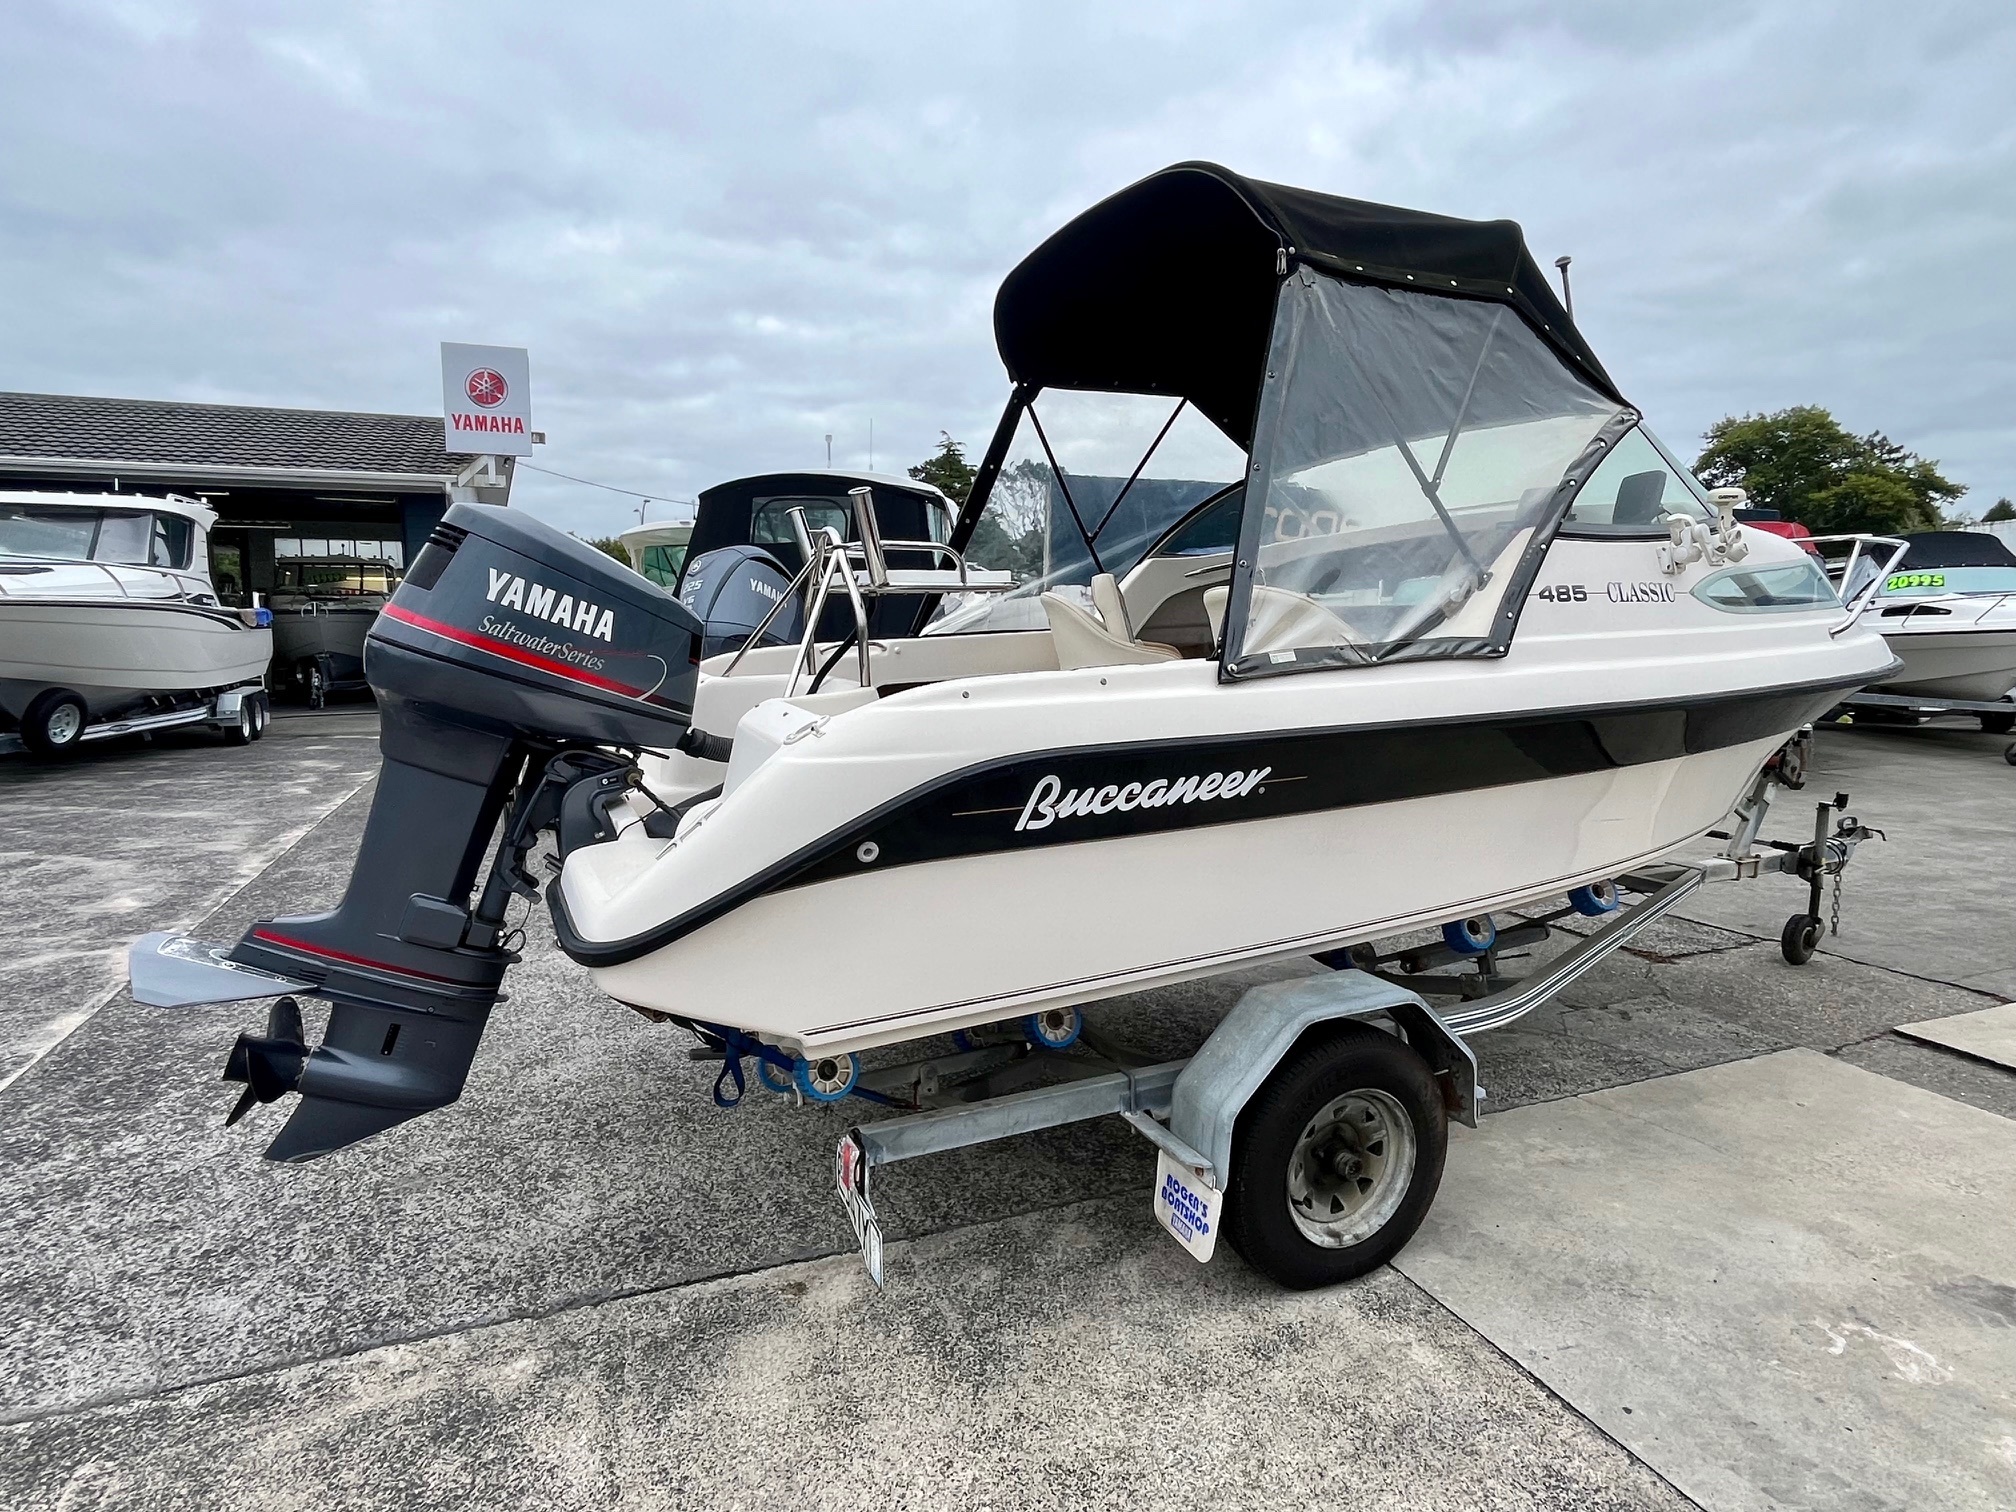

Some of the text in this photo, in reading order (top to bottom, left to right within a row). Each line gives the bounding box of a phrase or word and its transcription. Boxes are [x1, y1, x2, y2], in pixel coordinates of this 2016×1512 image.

[451, 413, 525, 434] YAMAHA
[682, 579, 704, 595] 225
[749, 577, 788, 609] YAMAH
[1538, 581, 1676, 604] 485 CLASSIC
[1887, 574, 1944, 591] 20995
[486, 567, 615, 643] YAMAHA
[1014, 766, 1272, 832] Buccaneer
[1161, 1185, 1210, 1236] BOATSHOP
[1166, 1173, 1208, 1219] ROGER'S
